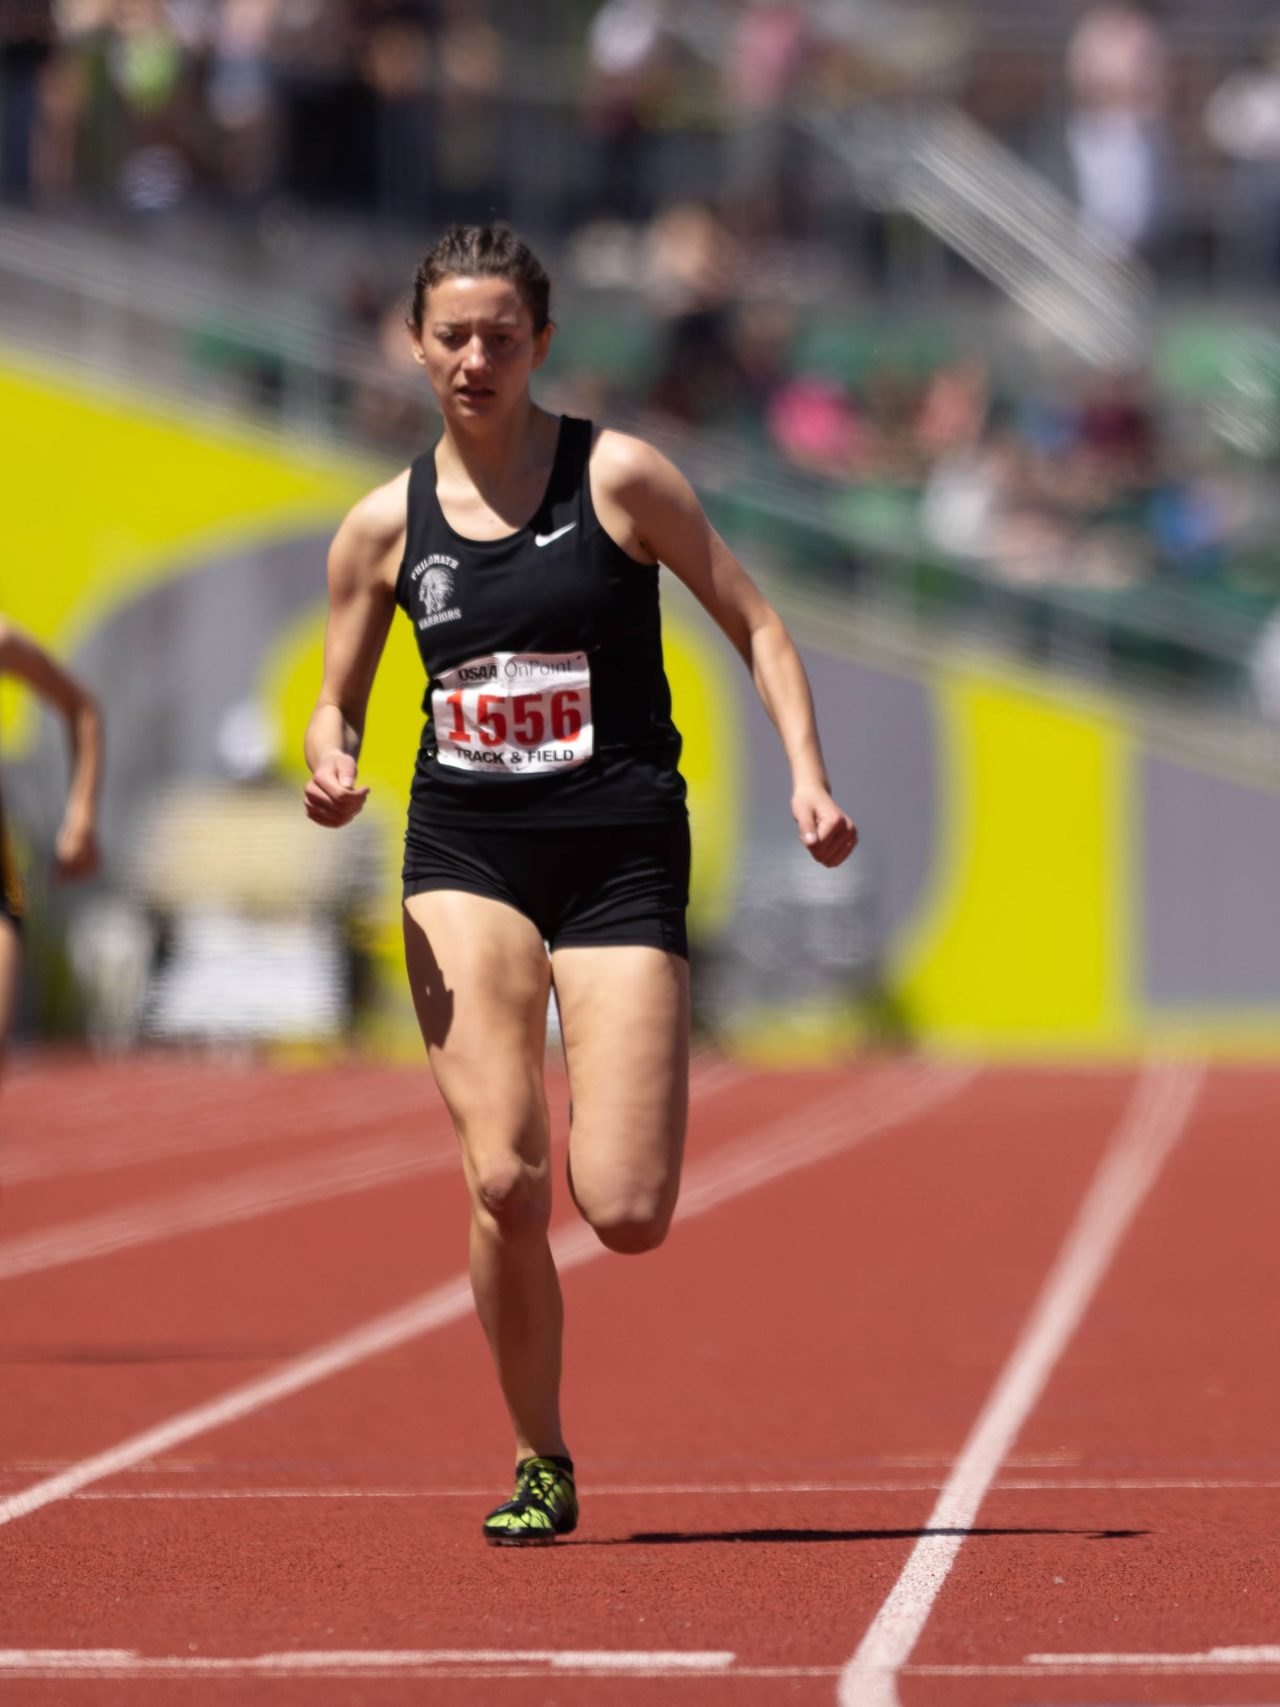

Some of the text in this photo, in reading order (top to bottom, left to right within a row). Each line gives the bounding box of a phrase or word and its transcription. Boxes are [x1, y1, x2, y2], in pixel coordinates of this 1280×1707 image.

[411, 553, 459, 581] PHILOMATH
[418, 608, 462, 630] WARRIORS
[457, 659, 573, 682] OSAA OnPoint
[446, 688, 582, 747] 1556
[455, 747, 574, 764] TRACK & FIELD
